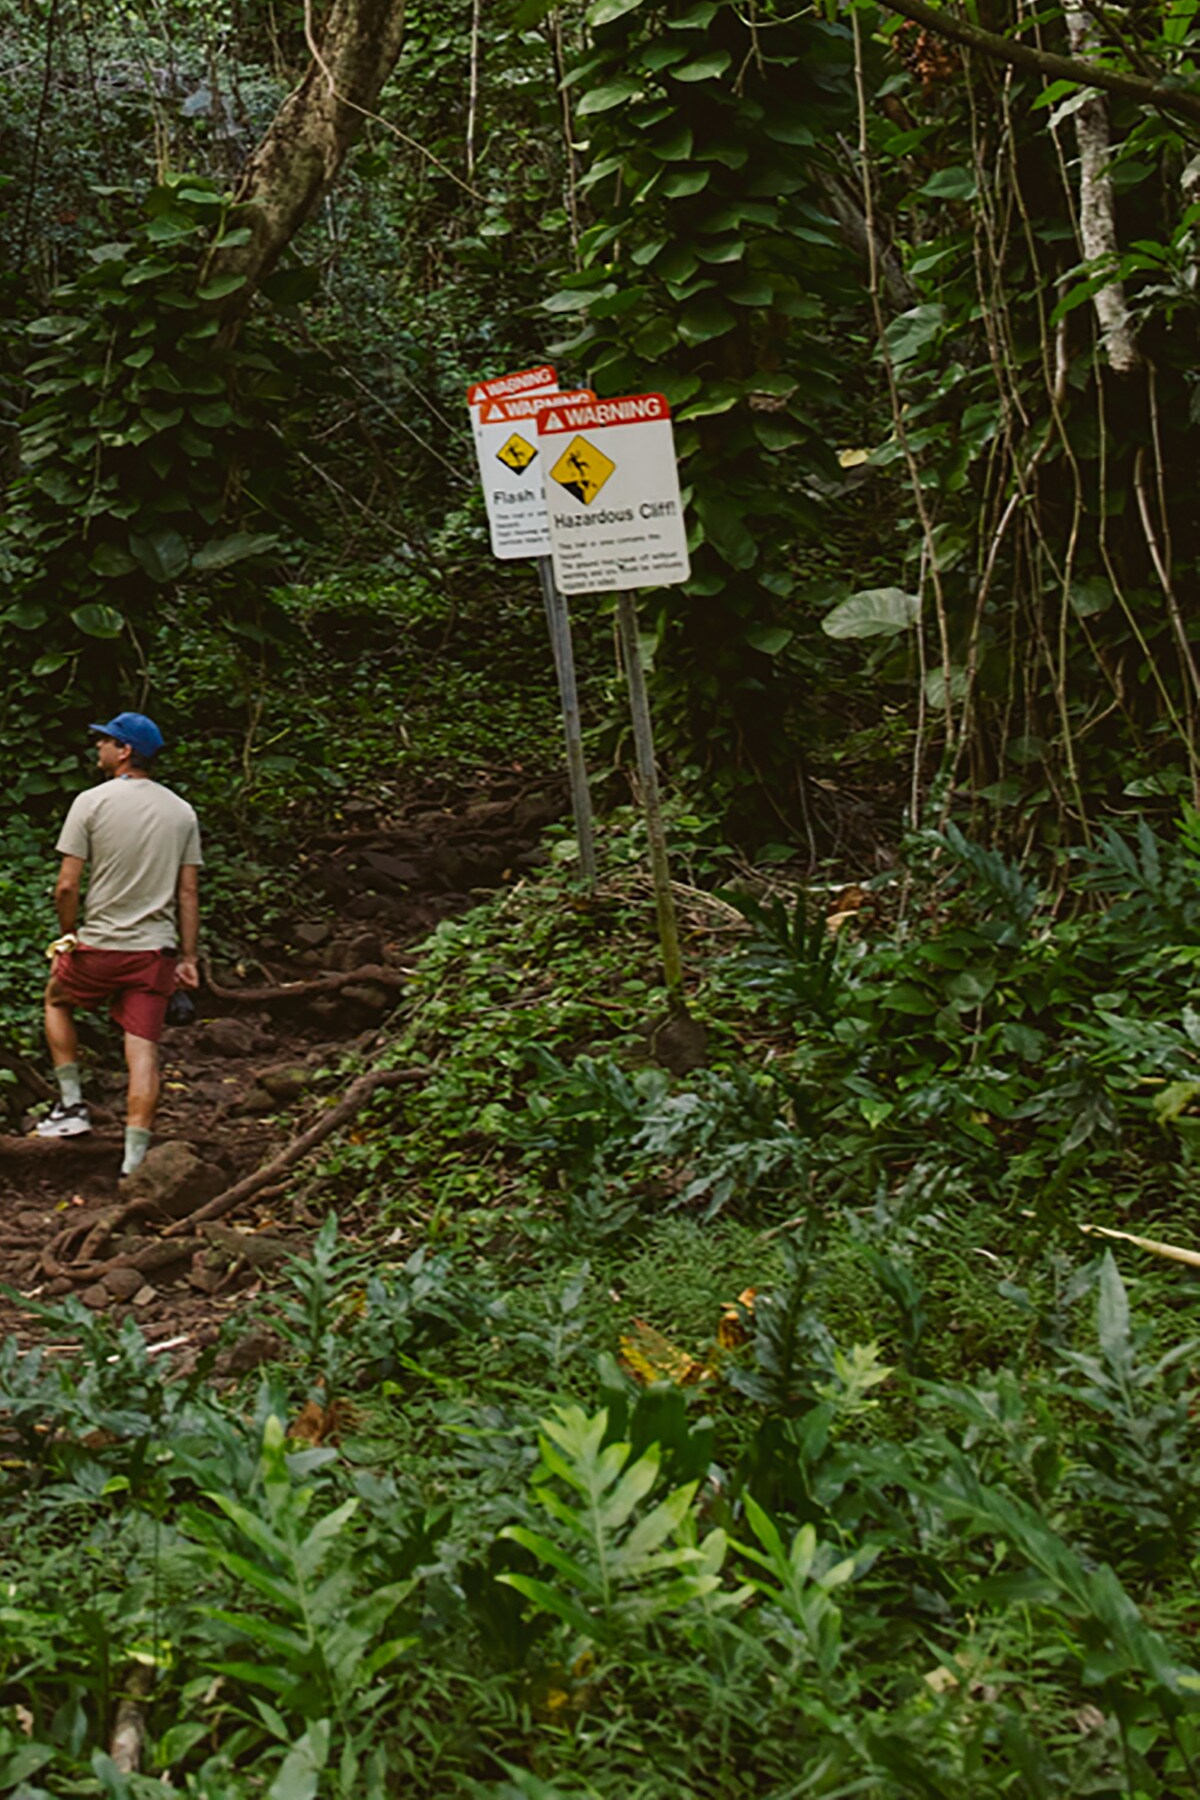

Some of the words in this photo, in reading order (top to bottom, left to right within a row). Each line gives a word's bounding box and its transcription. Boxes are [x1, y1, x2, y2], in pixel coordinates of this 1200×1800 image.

[486, 368, 551, 397] WARNING
[565, 398, 661, 426] WARNING
[493, 489, 535, 505] Flash
[554, 507, 634, 530] Hazardous
[640, 501, 676, 519] Cliff!
